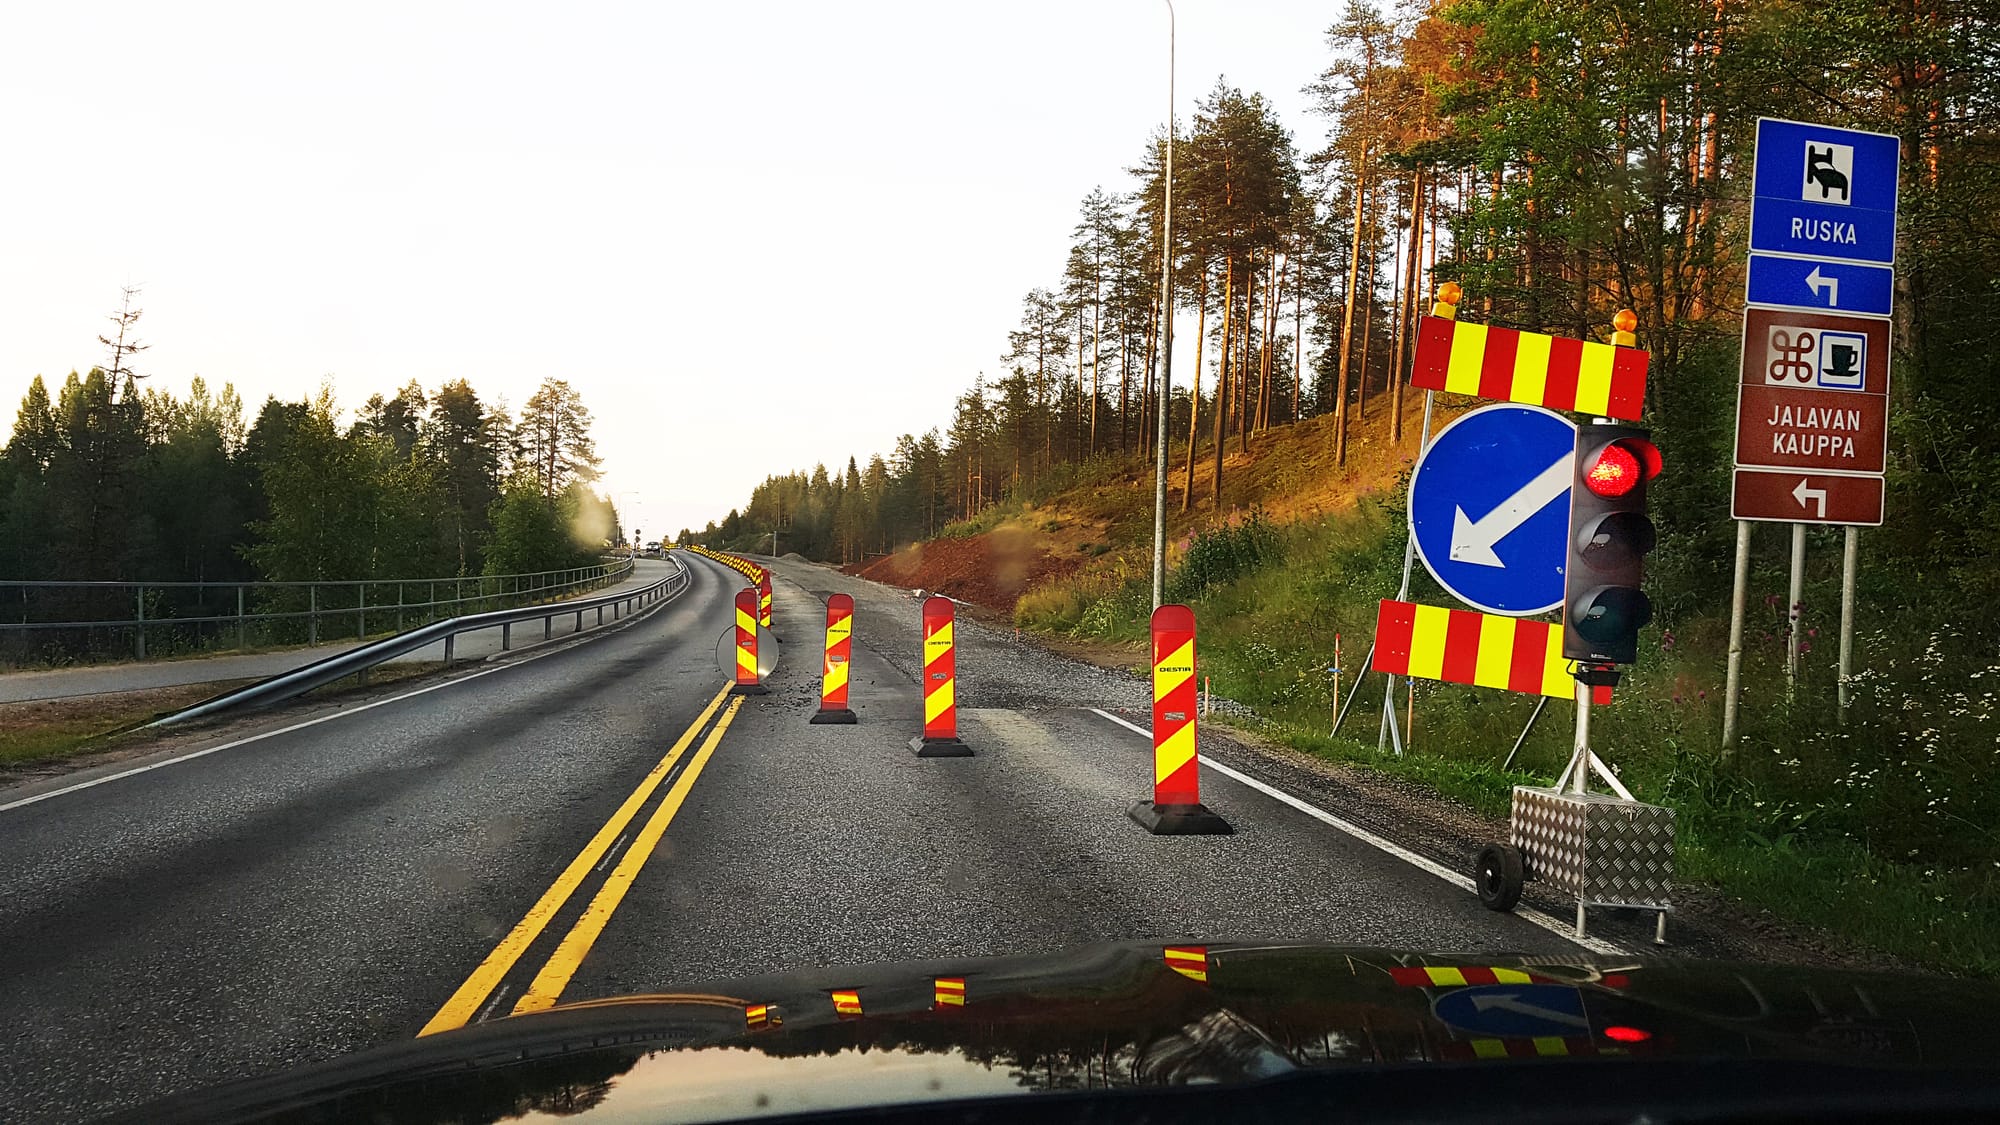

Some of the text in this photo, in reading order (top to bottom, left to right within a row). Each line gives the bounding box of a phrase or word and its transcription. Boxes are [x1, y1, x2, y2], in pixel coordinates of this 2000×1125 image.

[1791, 217, 1857, 245] RUSKA
[1767, 404, 1860, 431] JALAVAN
[1773, 432, 1855, 458] KAUPPA
